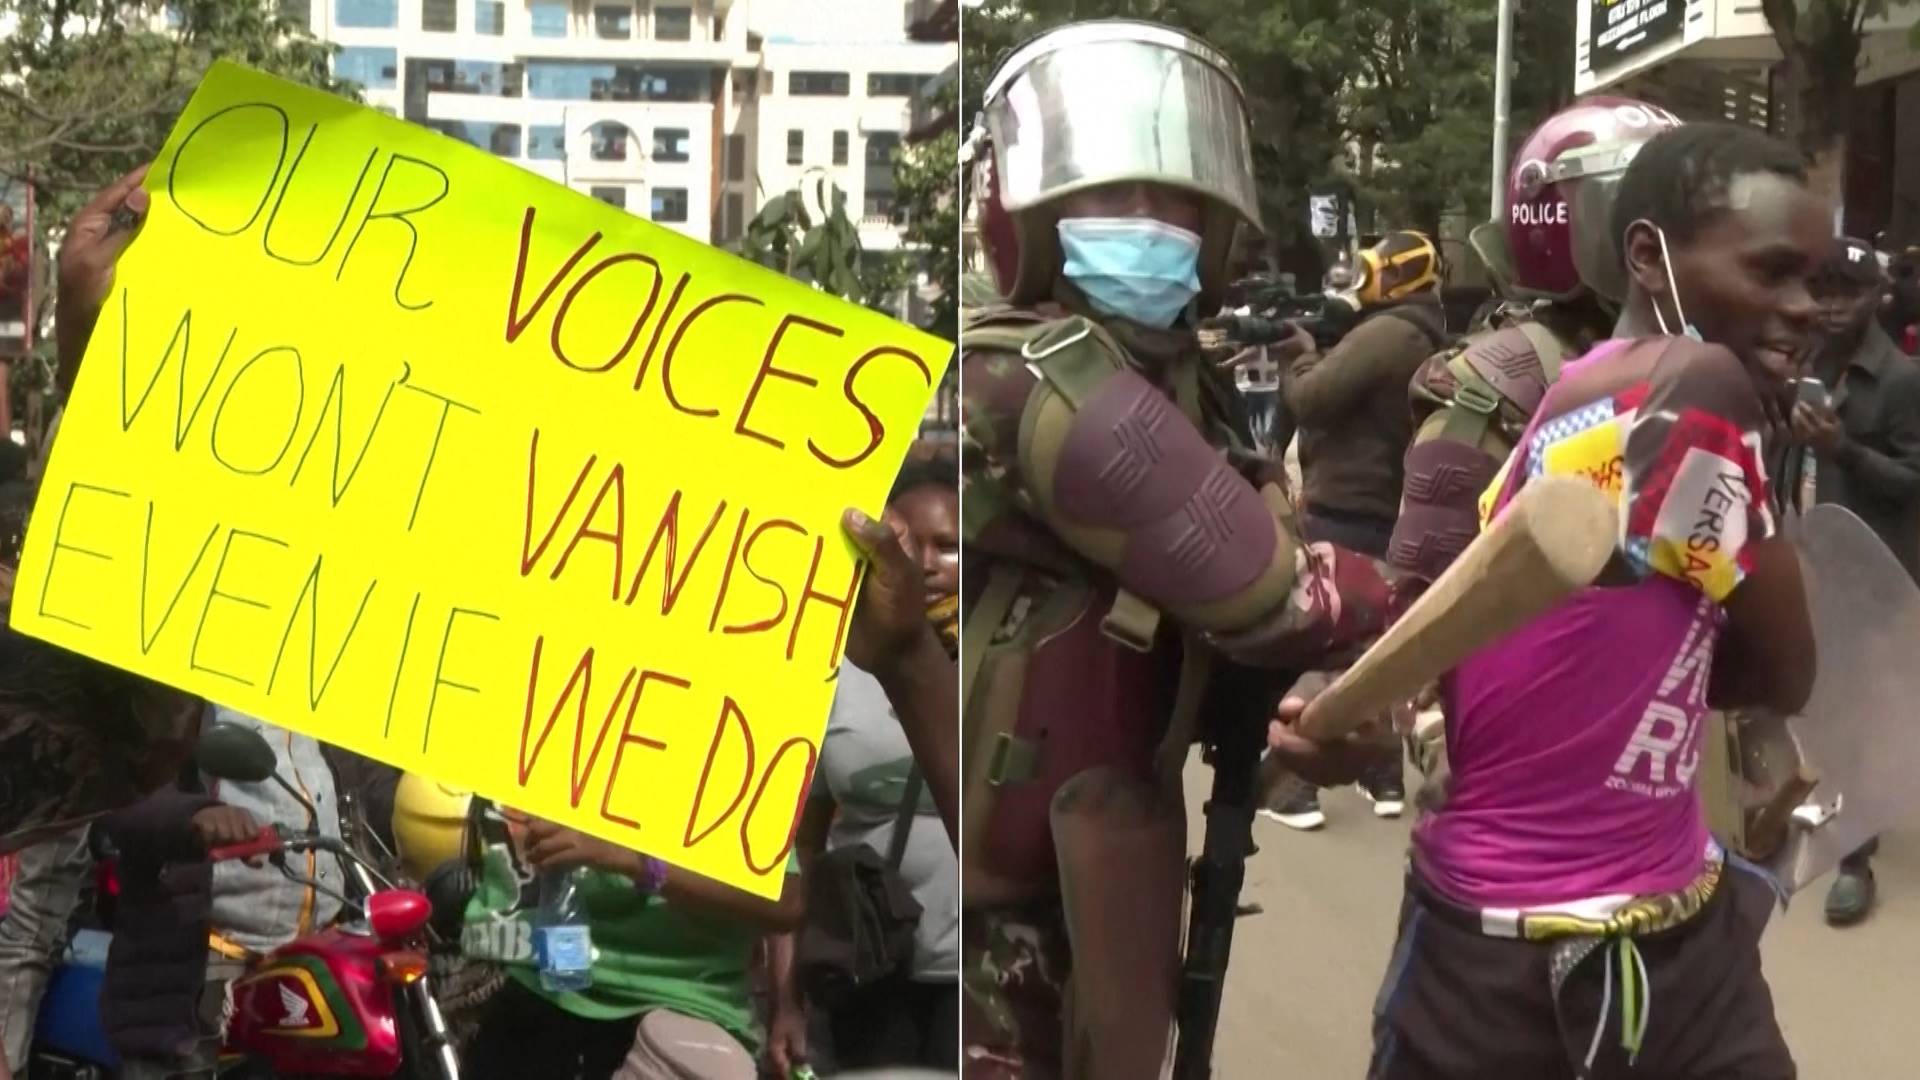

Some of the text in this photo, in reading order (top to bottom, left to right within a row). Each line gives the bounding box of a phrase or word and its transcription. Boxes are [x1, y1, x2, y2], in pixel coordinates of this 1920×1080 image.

[168, 103, 931, 468] OUR VOICES
[1512, 202, 1568, 225] POLICE
[123, 287, 481, 531] WON'T
[39, 482, 817, 875] EVEN IF WE DO
